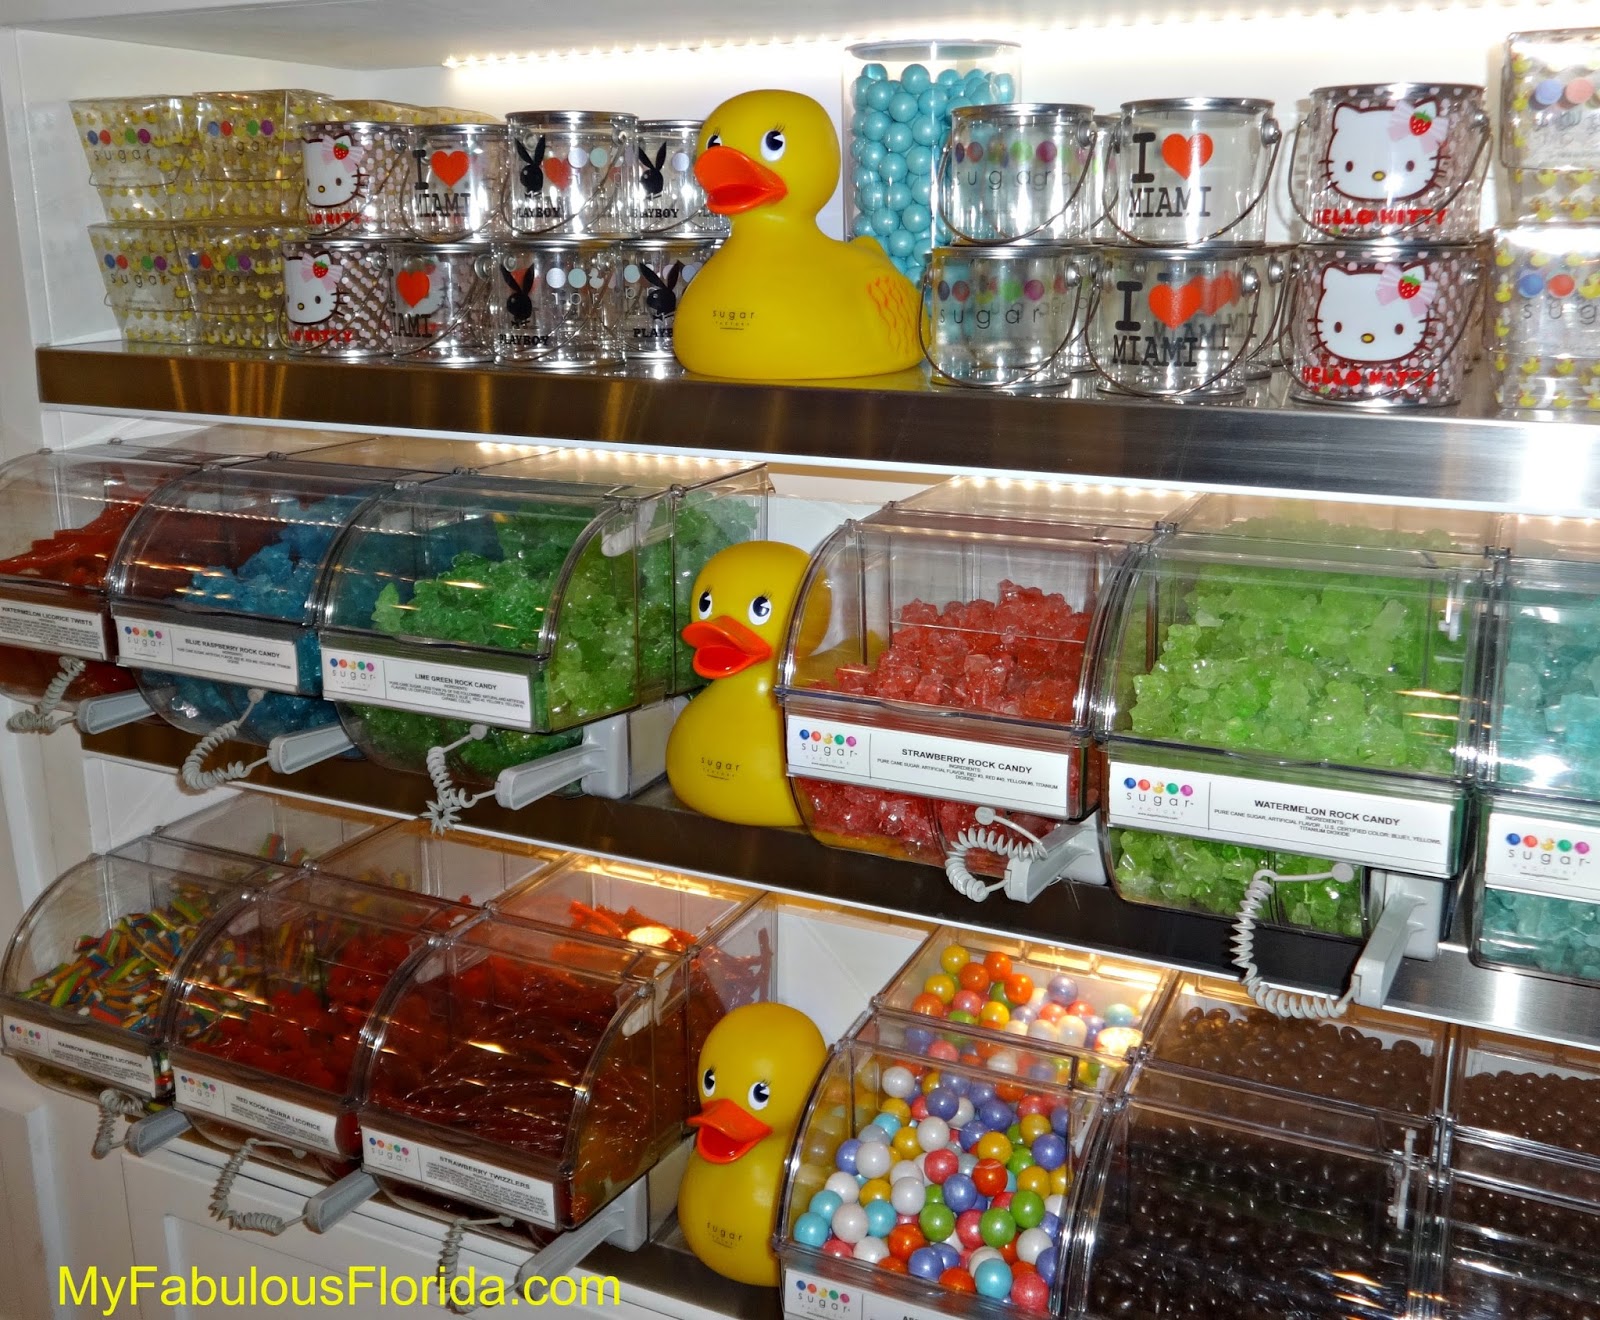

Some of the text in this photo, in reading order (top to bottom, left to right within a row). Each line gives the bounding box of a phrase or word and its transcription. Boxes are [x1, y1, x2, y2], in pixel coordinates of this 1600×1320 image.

[1132, 132, 1156, 183] I
[412, 149, 429, 190] I
[1129, 186, 1211, 217] MIAMI
[630, 208, 679, 218] AYBOY
[1380, 208, 1447, 225] KITTY
[712, 310, 755, 320] sugar
[1115, 281, 1143, 331] I
[390, 312, 433, 336] IAMI
[940, 307, 1040, 329] sugar
[499, 333, 550, 346] PLAYBOY
[633, 328, 673, 338] PLAYB
[1112, 334, 1198, 367] MIAMI
[1302, 366, 1362, 387] HELLO
[185, 638, 201, 646] BLUE
[202, 640, 238, 651] RASPBERRY
[239, 647, 257, 655] ROCK
[258, 650, 280, 658] CANDY
[332, 669, 374, 681] sugar
[414, 673, 497, 690] LIME GREEN ROCK CANDY
[801, 742, 854, 758] sugar
[701, 756, 740, 771] sugar
[901, 748, 1032, 774] STRAWBERRY ROCK CANDY
[1126, 792, 1190, 808] sugar
[1214, 808, 1229, 816] PURE
[1268, 816, 1297, 825] ARTIFICIAL
[1337, 825, 1367, 835] CERTIFIED
[1254, 799, 1400, 827] WATERMELON ROCK CANDY
[1299, 825, 1350, 837] TITANIUM DIOXIDE
[1507, 849, 1586, 866] sugar
[249, 1099, 291, 1120] KOOKABURRA
[292, 1116, 321, 1131] LICORICE
[439, 1156, 530, 1190] STRAWBERRY TWIZZLERS
[706, 1222, 742, 1241] sugar
[798, 1292, 847, 1313] sugar
